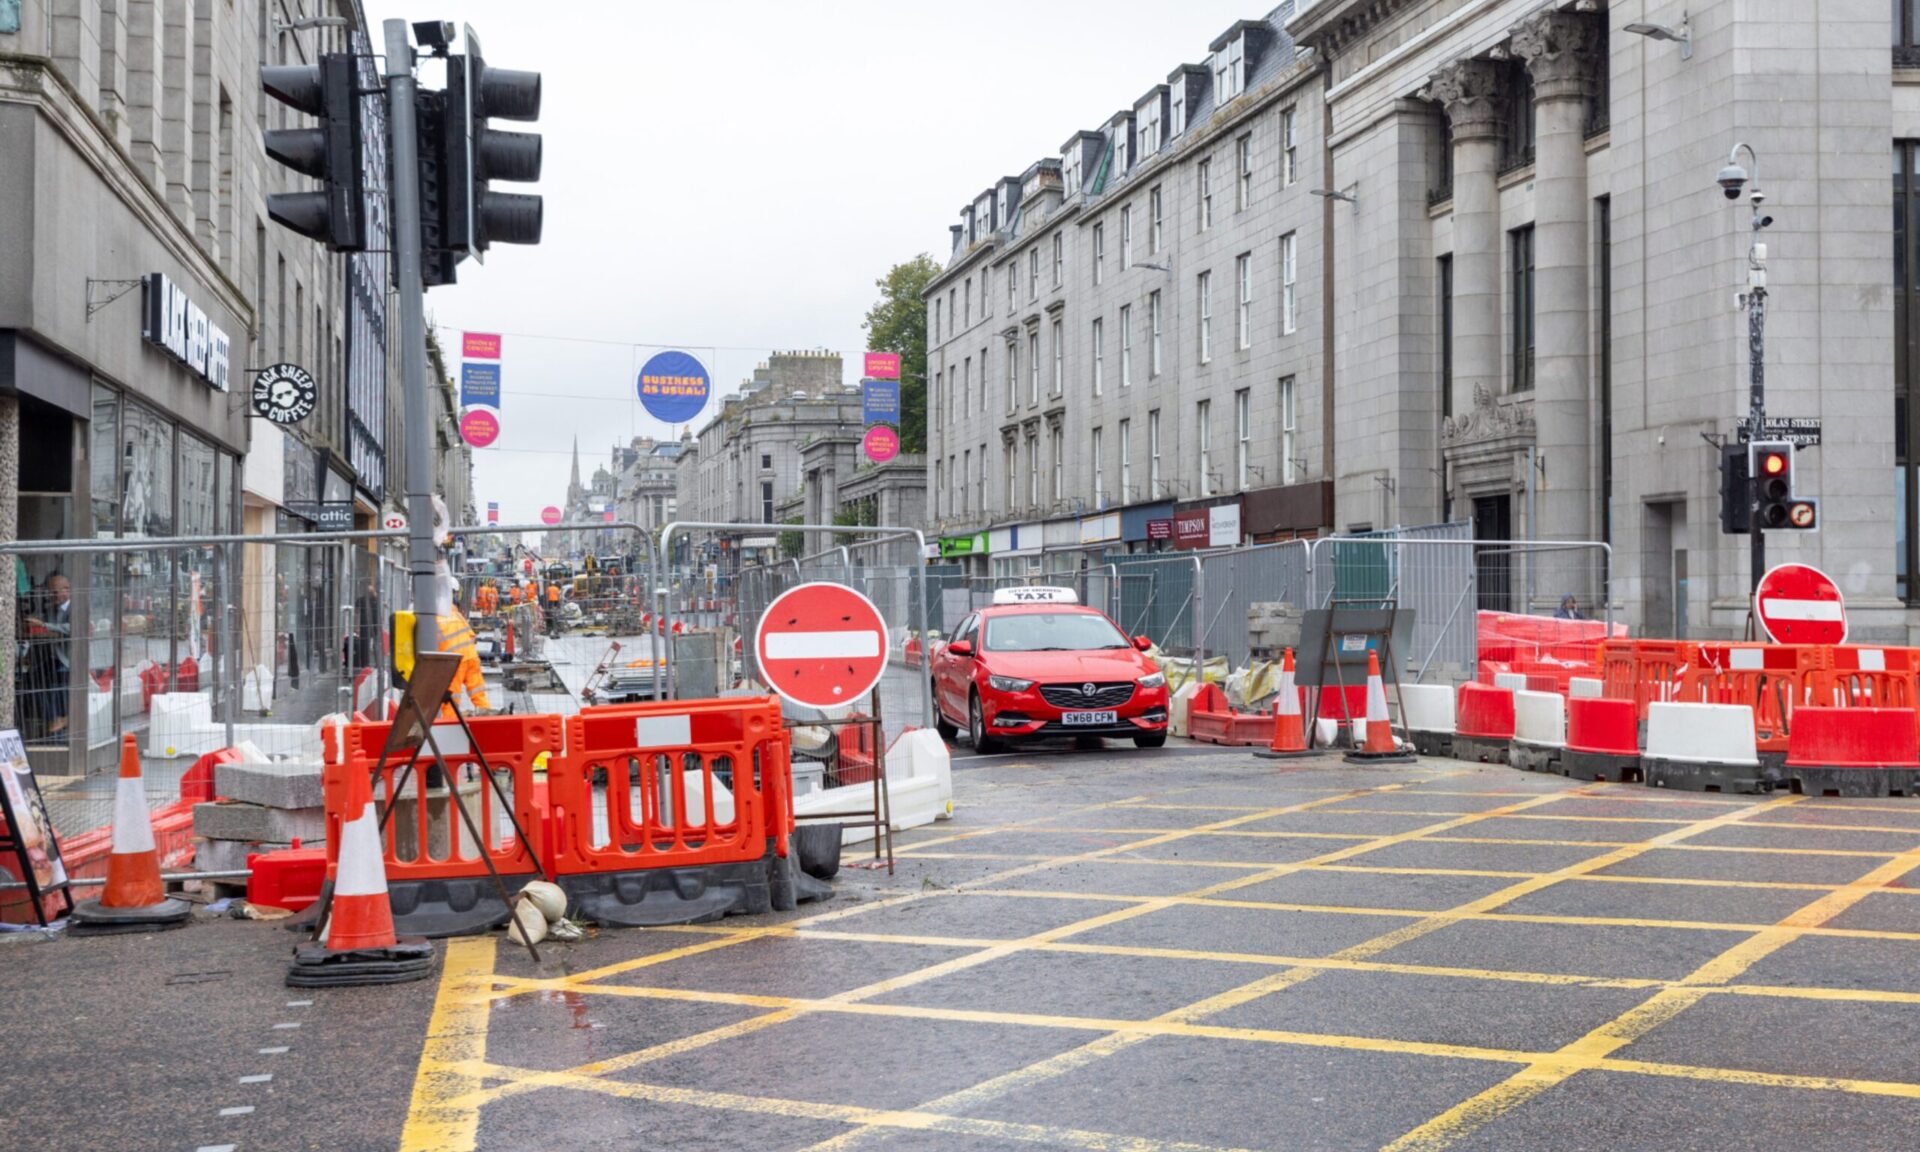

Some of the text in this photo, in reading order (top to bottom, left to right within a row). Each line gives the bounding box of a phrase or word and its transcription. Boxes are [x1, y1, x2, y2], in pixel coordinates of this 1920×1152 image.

[254, 365, 314, 400] BLACK SHEEP
[642, 375, 704, 386] BUSINESS
[643, 384, 706, 396] AS USUAL!
[268, 399, 313, 422] COFFEE
[1791, 418, 1820, 428] STREET
[320, 510, 351, 521] attic
[1178, 518, 1205, 534] TIMPSON
[1066, 711, 1115, 723] SW68 CFM
